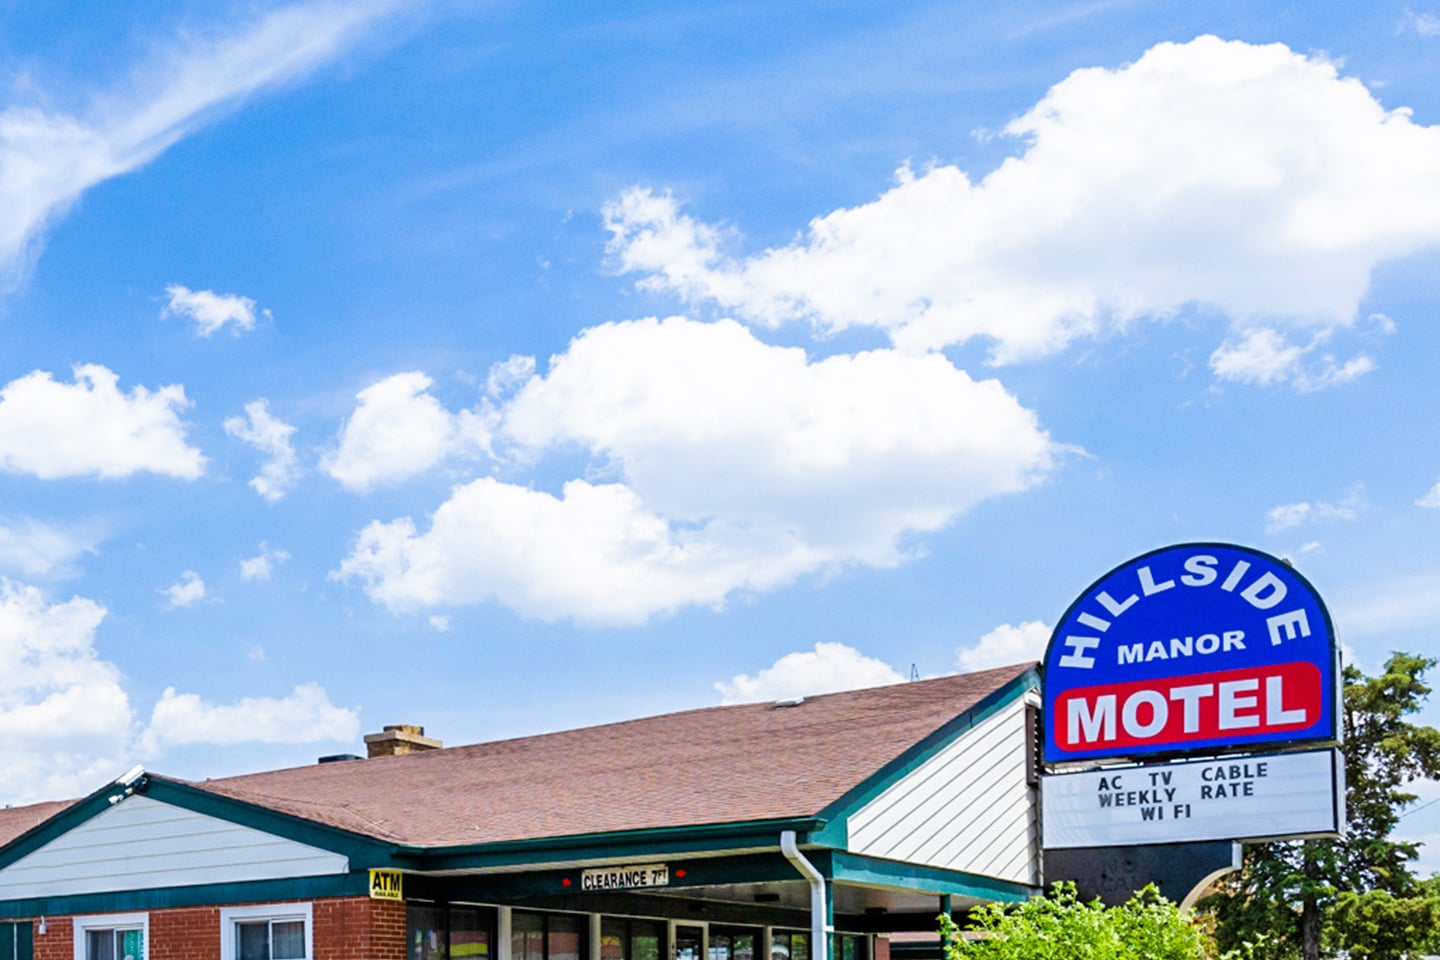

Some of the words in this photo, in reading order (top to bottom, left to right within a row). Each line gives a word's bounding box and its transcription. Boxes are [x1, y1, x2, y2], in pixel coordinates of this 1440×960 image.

[1059, 555, 1311, 668] HILLSIDE
[1117, 630, 1247, 665] MANOR
[1066, 675, 1307, 744] MOTEL
[1098, 776, 1122, 791] AC
[1149, 771, 1173, 786] TV
[1201, 762, 1268, 781] CABLE
[1098, 788, 1176, 808] WEEKLY
[1201, 782, 1254, 799] RATE
[1141, 806, 1163, 821] WI
[1174, 804, 1191, 819] FI
[372, 871, 400, 891] ATM
[584, 870, 647, 889] CLEARANCE
